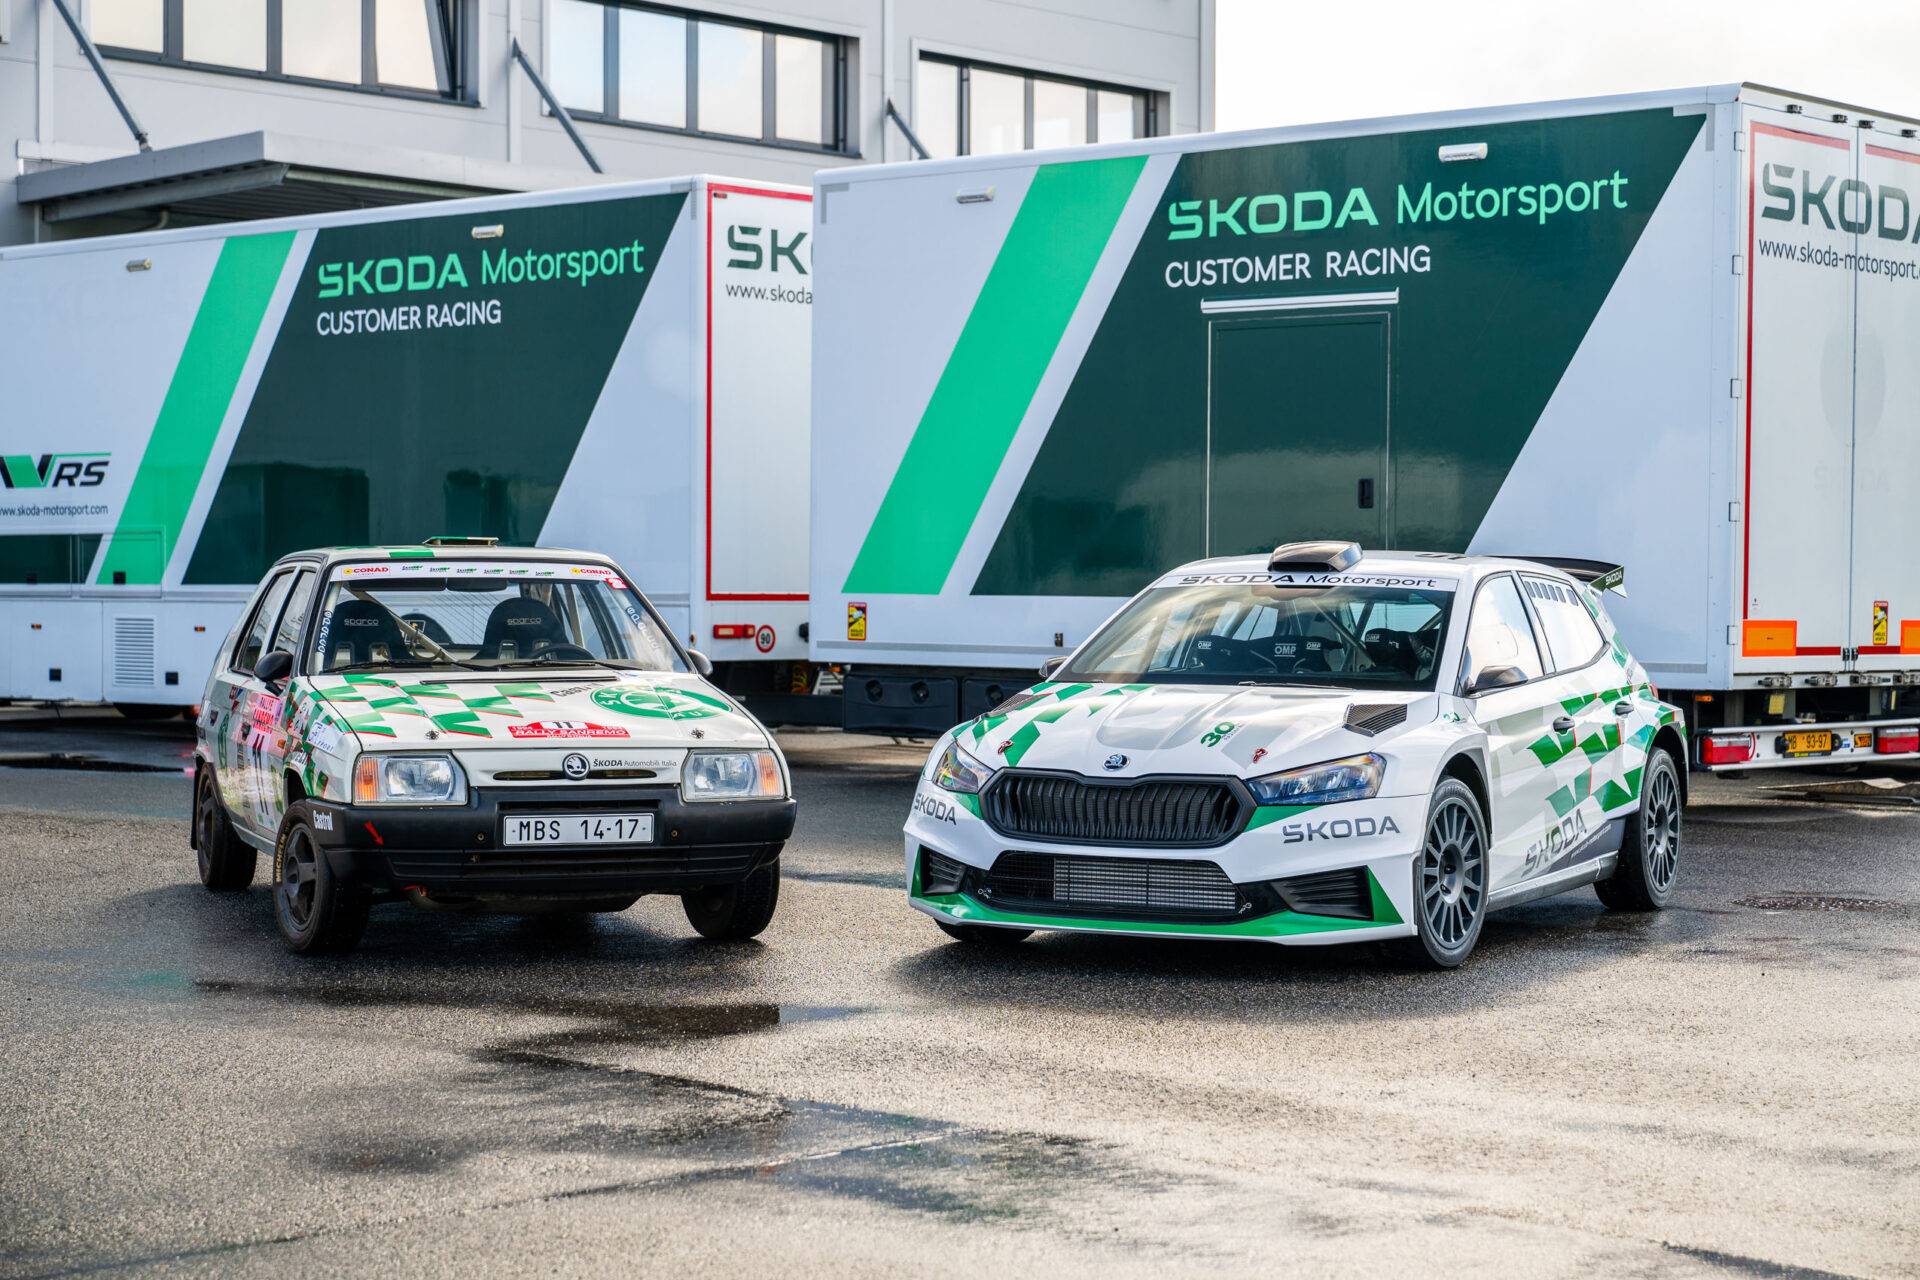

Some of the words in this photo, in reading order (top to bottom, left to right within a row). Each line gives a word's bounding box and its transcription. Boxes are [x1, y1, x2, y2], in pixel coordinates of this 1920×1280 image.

[1397, 170, 1629, 225] Motorsport
[727, 224, 813, 275] SK
[481, 239, 645, 287] Motorsport
[1164, 252, 1311, 289] CUSTOMER
[1325, 244, 1432, 278] RACING
[317, 305, 422, 336] CUSTOMER
[426, 299, 502, 330] RACING
[580, 568, 612, 576] CONAD
[1306, 574, 1436, 588] Motorsport
[760, 633, 771, 645] 90
[1197, 641, 1212, 649] OMP
[1306, 641, 1321, 650] OMP
[1274, 645, 1297, 656] OMP
[552, 721, 574, 729] 11
[1200, 721, 1235, 748] 30
[1806, 733, 1828, 749] 93-97
[593, 758, 623, 767] ŠKODA
[624, 759, 660, 767] Automobili
[313, 810, 334, 831] Castrol
[519, 819, 561, 841] MBS
[580, 818, 640, 841] 14-17
